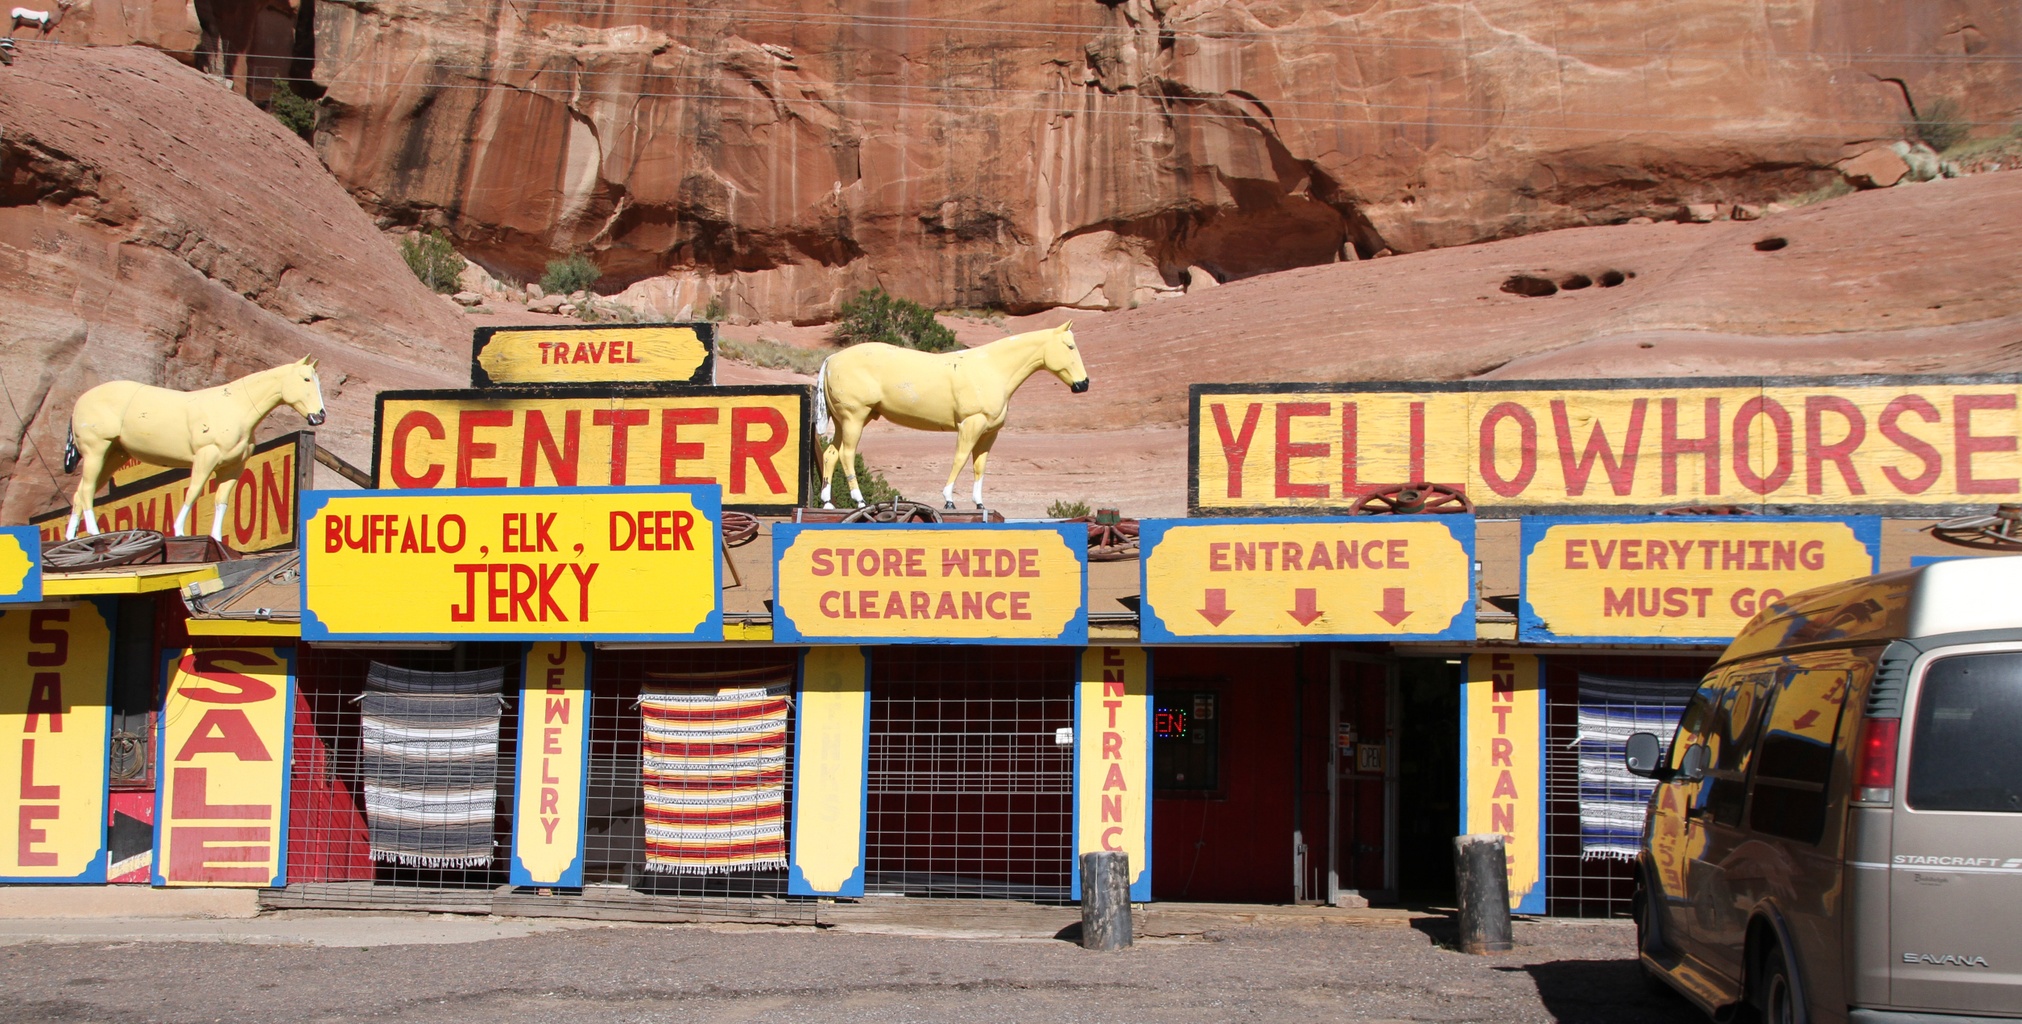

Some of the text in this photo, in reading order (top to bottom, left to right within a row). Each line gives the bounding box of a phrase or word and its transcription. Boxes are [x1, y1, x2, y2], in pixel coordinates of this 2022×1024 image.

[538, 341, 640, 364] TRAVEL
[390, 406, 790, 494] CENTER
[1209, 394, 2019, 499] YELLOWHORSE
[609, 510, 695, 551] DEER
[811, 548, 1040, 578] STORE WIDE
[1209, 539, 1410, 572] ENTRANCE
[1564, 539, 1825, 571] EVERYTHING
[451, 563, 600, 622] JERKY
[819, 590, 1033, 620] CLEARANCE
[1603, 587, 1714, 618] MUST
[18, 608, 69, 867] SALE
[539, 641, 571, 845] JEWELRY
[168, 650, 278, 884] SALE
[1894, 855, 2001, 867] STARCRAFT
[1903, 952, 1989, 968] SAVANA
